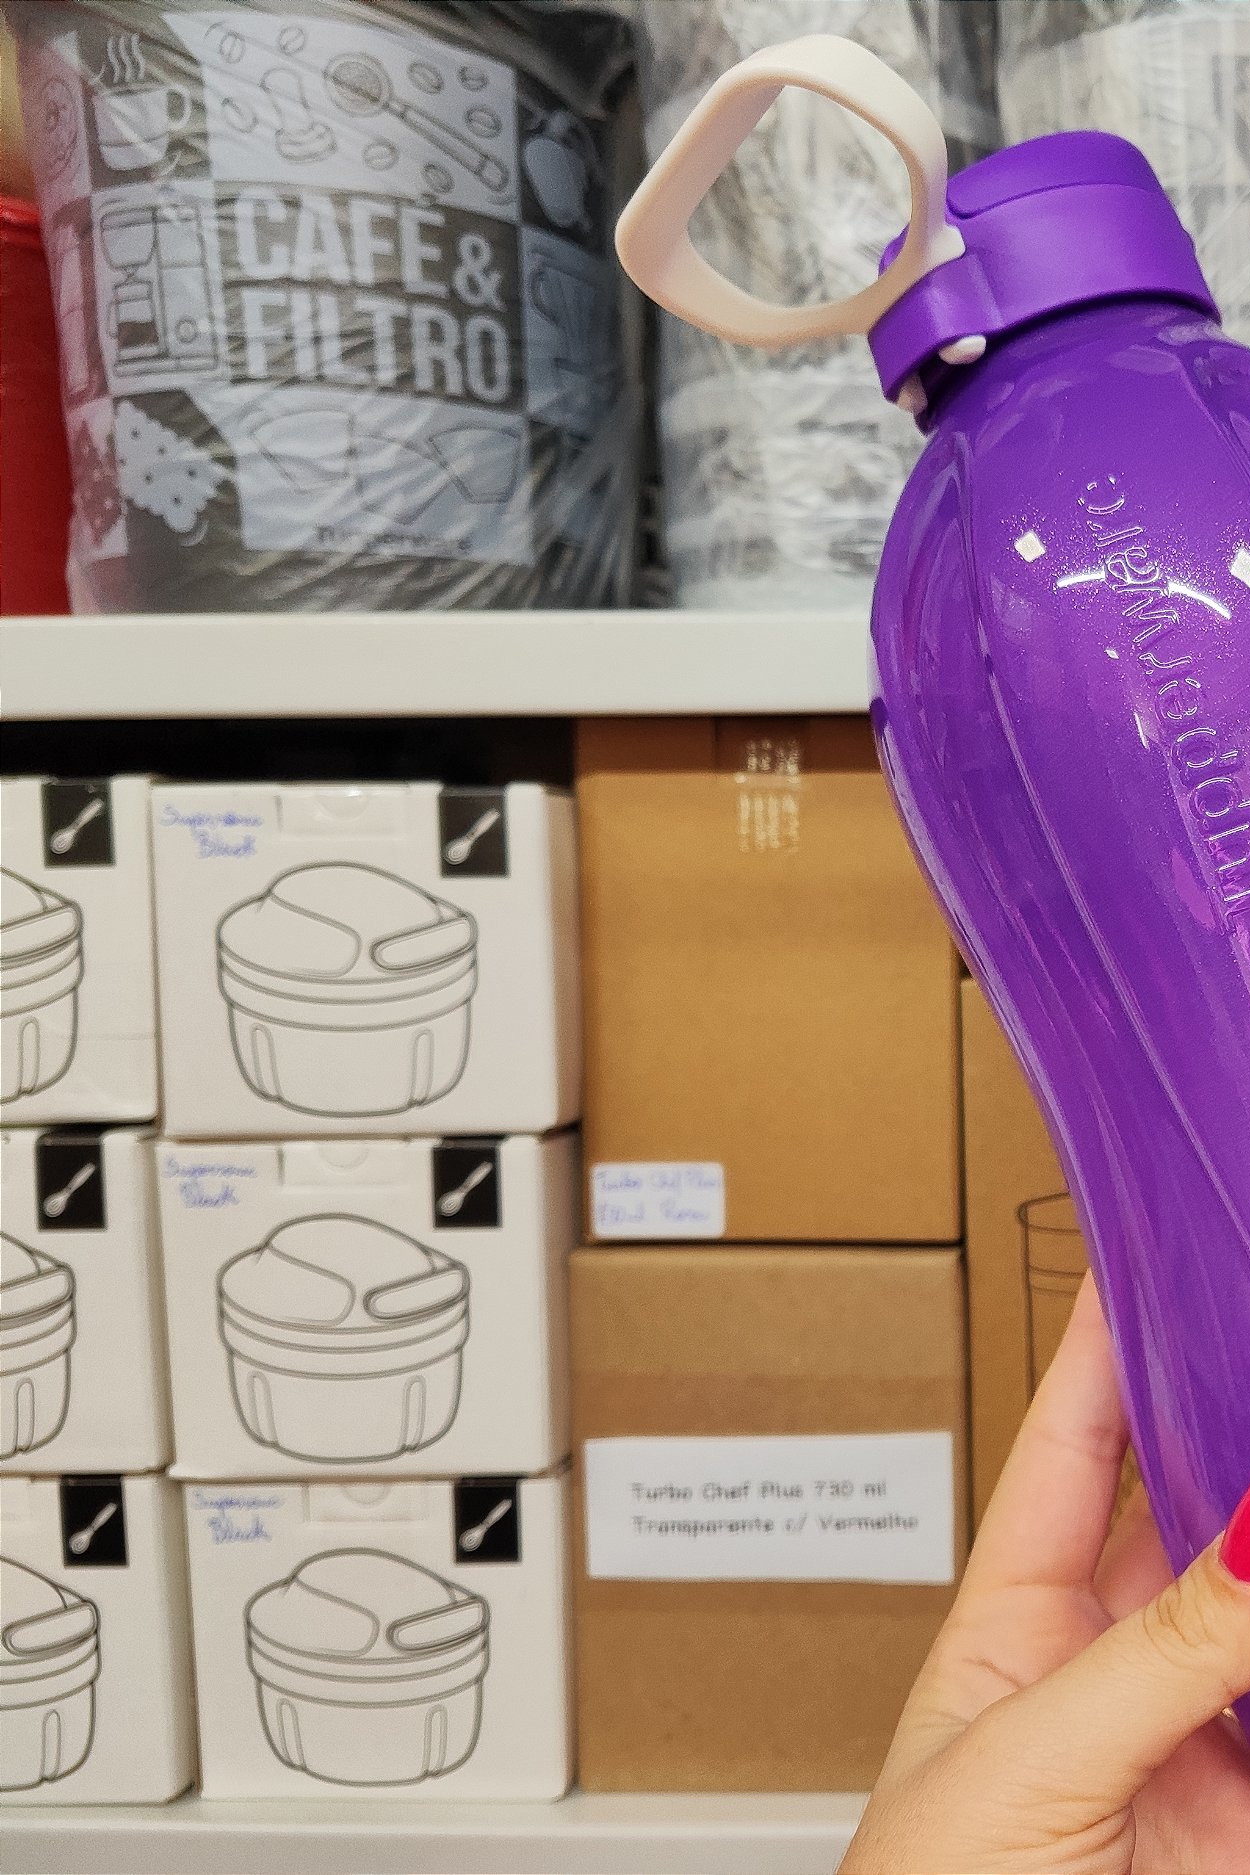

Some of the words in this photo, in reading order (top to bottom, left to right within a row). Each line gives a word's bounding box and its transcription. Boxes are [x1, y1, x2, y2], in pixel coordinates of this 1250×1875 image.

[455, 233, 501, 310] &
[243, 289, 512, 401] FILTRO
[631, 1481, 694, 1501] Turbo
[702, 1480, 750, 1500] Chef
[760, 1480, 804, 1499] Plus
[631, 1515, 775, 1537] Transparente
[819, 1513, 920, 1532] Vermelho
